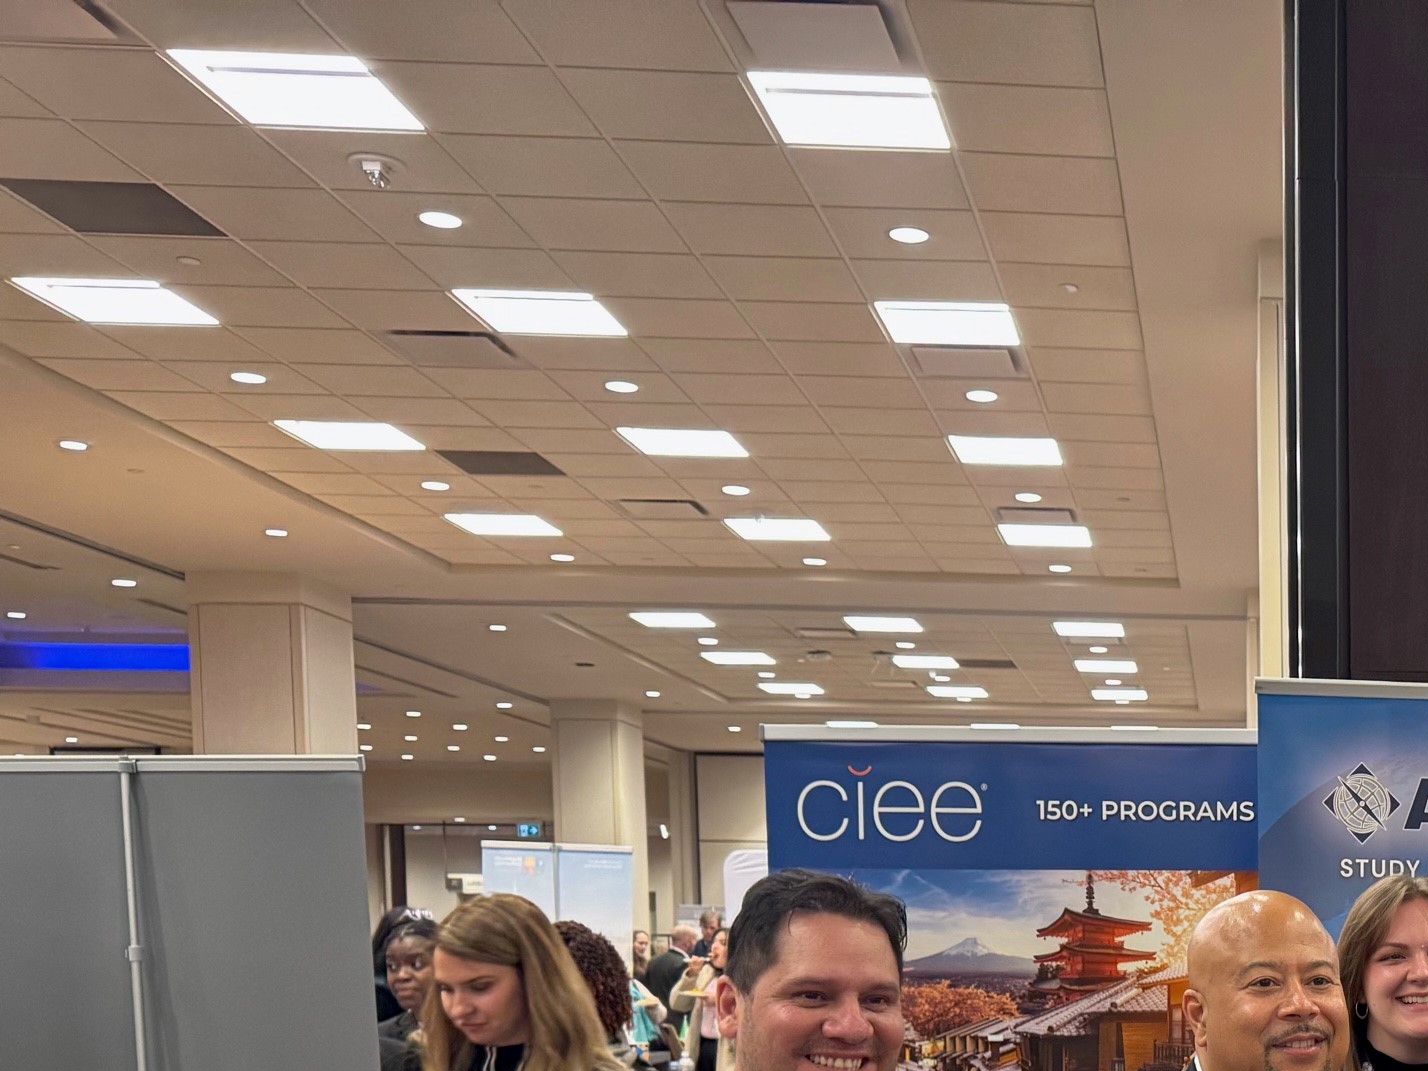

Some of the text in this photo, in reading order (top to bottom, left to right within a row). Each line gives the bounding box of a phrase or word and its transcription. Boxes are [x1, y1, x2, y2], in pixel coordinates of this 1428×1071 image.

[1036, 799, 1256, 822] 150+ PROGRAMS
[1339, 858, 1420, 879] STUDY
